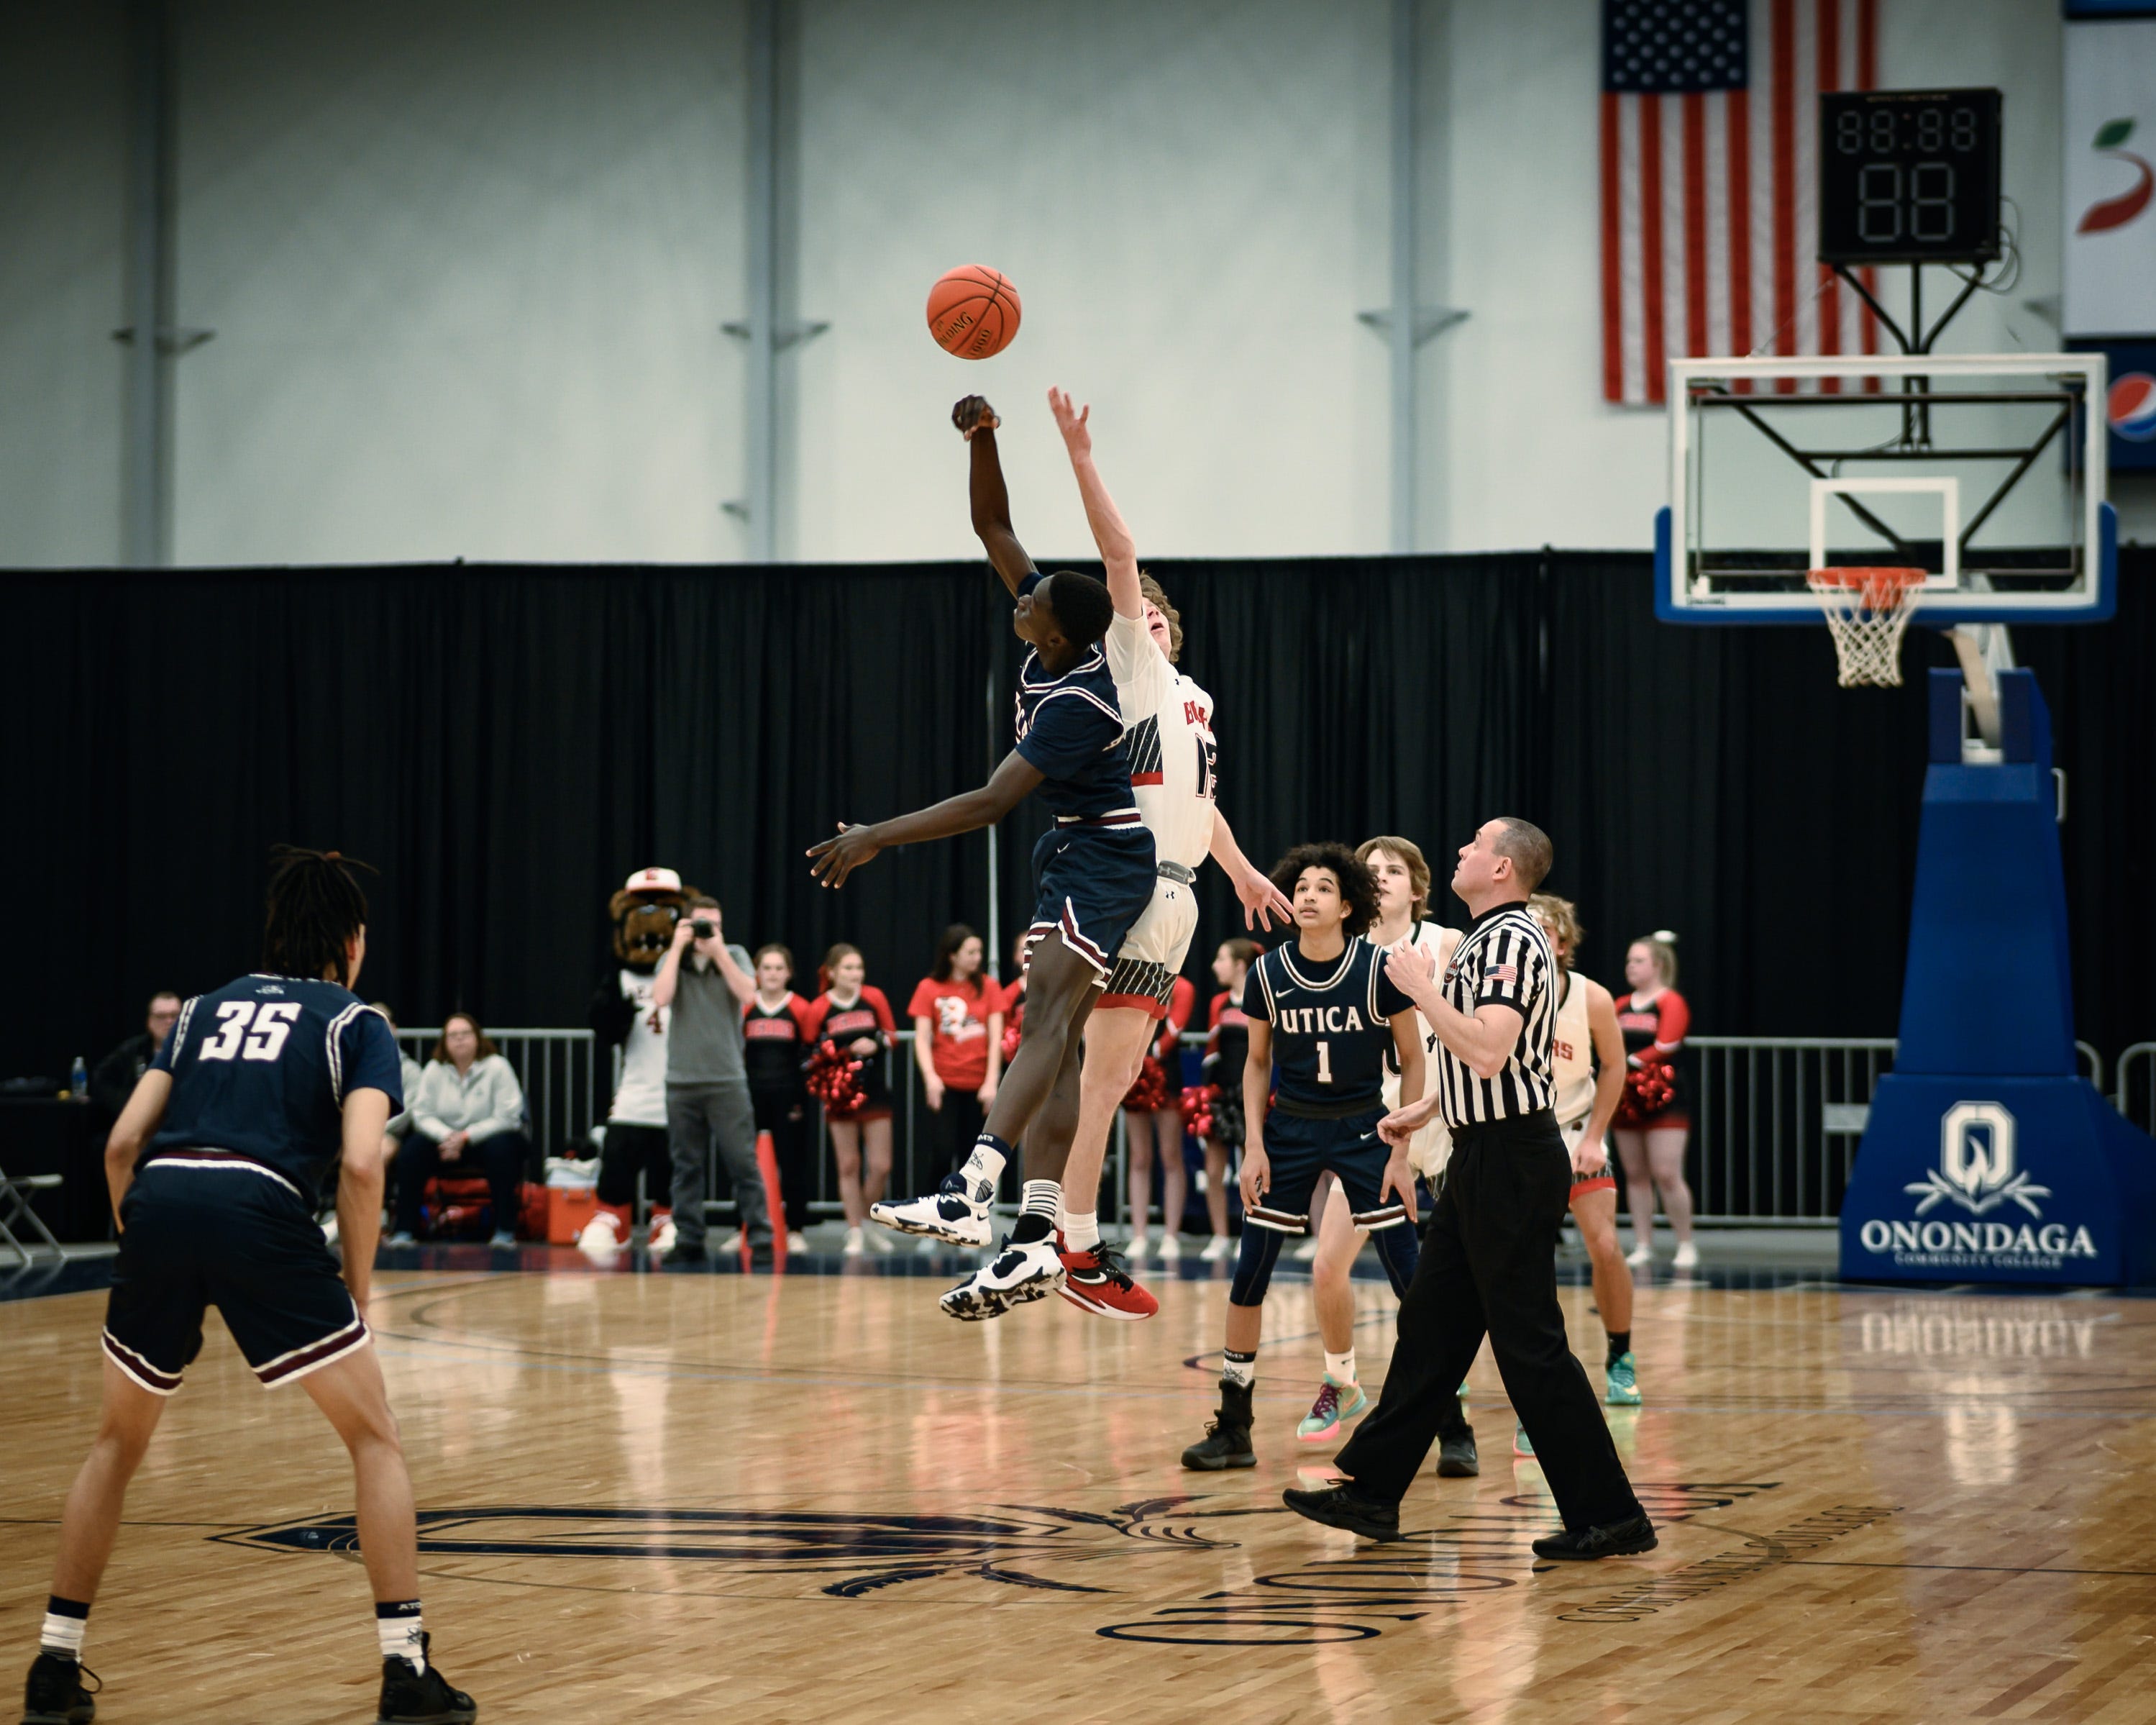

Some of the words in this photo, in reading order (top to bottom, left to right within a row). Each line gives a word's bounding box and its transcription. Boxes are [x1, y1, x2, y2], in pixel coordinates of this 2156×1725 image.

[198, 1001, 302, 1061] 35
[1280, 1006, 1364, 1033] UTICA
[1316, 1042, 1332, 1082] 1
[1860, 1219, 2098, 1258] ONONDAGA
